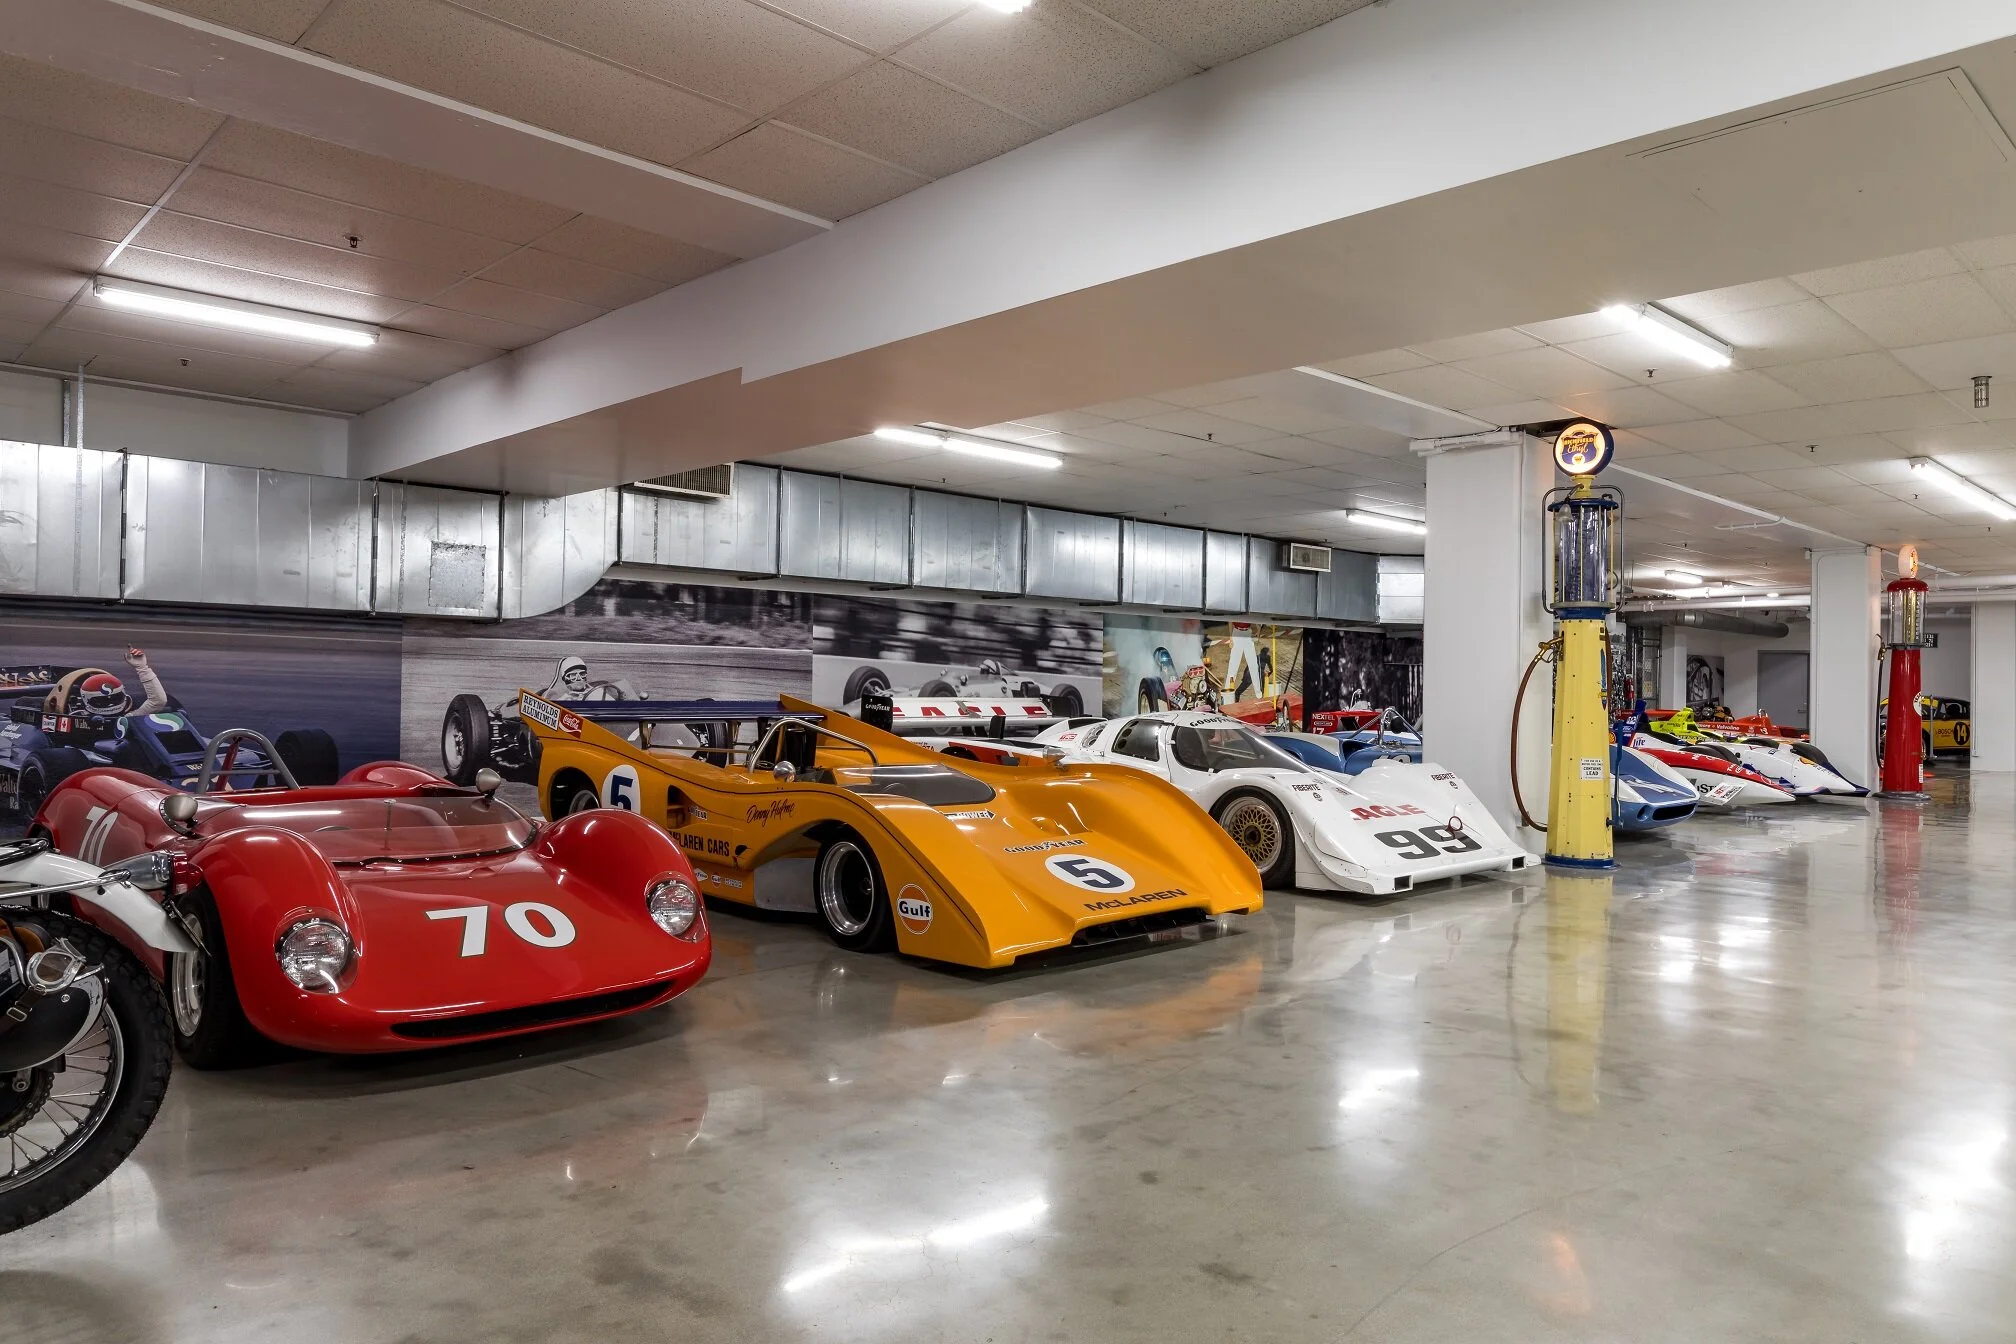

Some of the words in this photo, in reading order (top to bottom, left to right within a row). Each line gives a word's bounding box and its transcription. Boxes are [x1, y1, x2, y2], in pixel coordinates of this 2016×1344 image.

[522, 705, 557, 728] ALUMINUM
[523, 695, 559, 718] REYNOLDS
[865, 703, 891, 712] GOODYEAR
[1312, 713, 1335, 721] NEXTEL
[1957, 724, 1967, 742] 14
[610, 774, 634, 811] 5
[746, 804, 770, 828] Denny
[1350, 804, 1426, 821] AGLE
[707, 838, 730, 857] CARS
[1004, 839, 1085, 853] GOODYEAR
[1374, 825, 1482, 860] 99
[1053, 858, 1126, 889] 5
[899, 900, 931, 918] Gulf
[1084, 888, 1188, 911] McLAREN
[425, 901, 576, 957] 70
